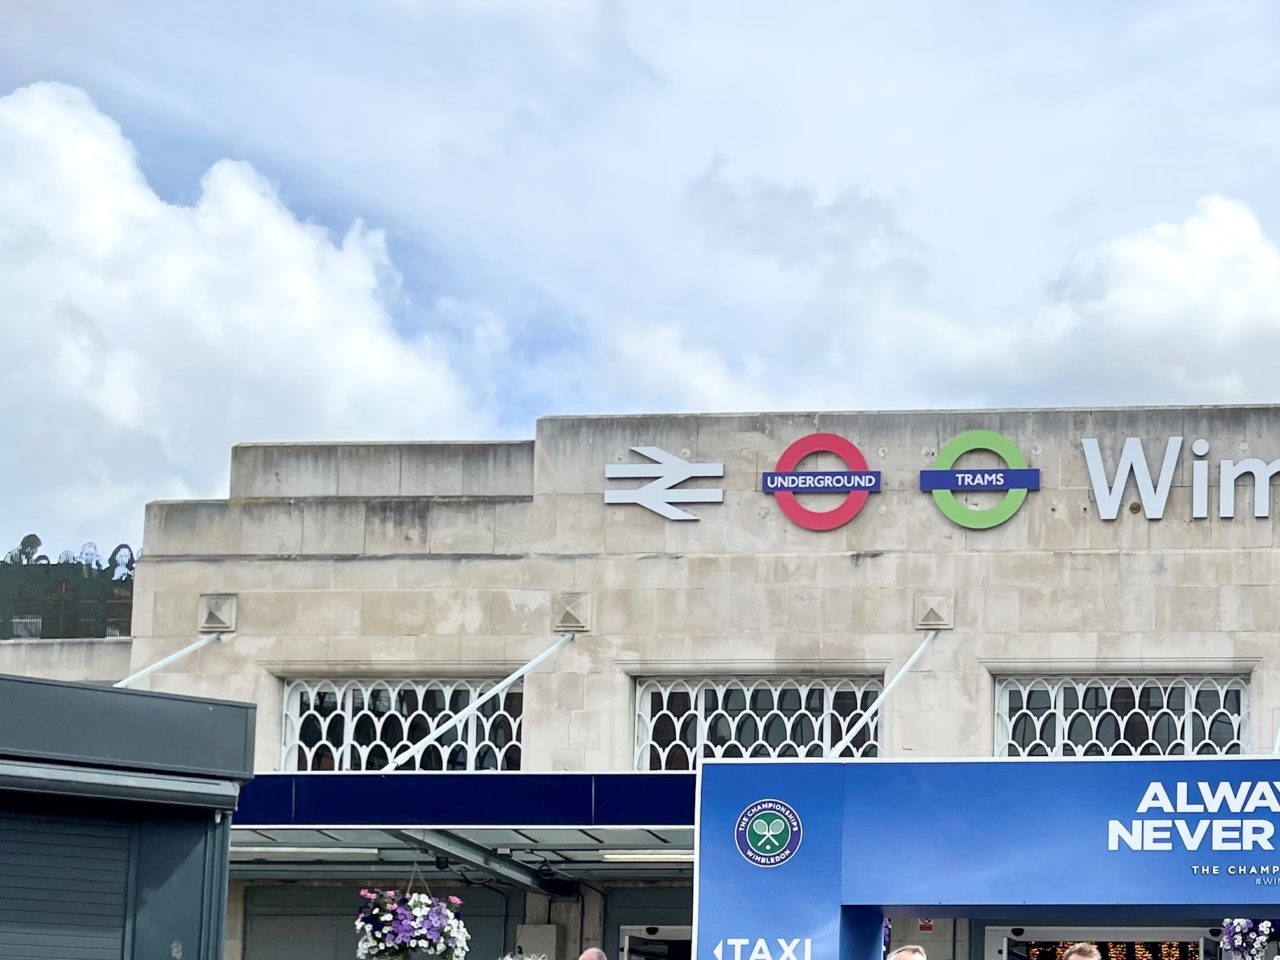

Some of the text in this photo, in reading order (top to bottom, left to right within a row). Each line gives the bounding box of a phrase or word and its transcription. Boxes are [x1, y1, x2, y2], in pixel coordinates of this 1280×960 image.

[766, 473, 876, 489] UNDERGROUND
[955, 472, 1004, 486] TRAMS
[738, 802, 799, 832] THE CHAMPIONSHIPS
[1107, 819, 1275, 851] NEVER
[746, 848, 791, 864] WIMBLEDON
[1191, 865, 1220, 875] THE
